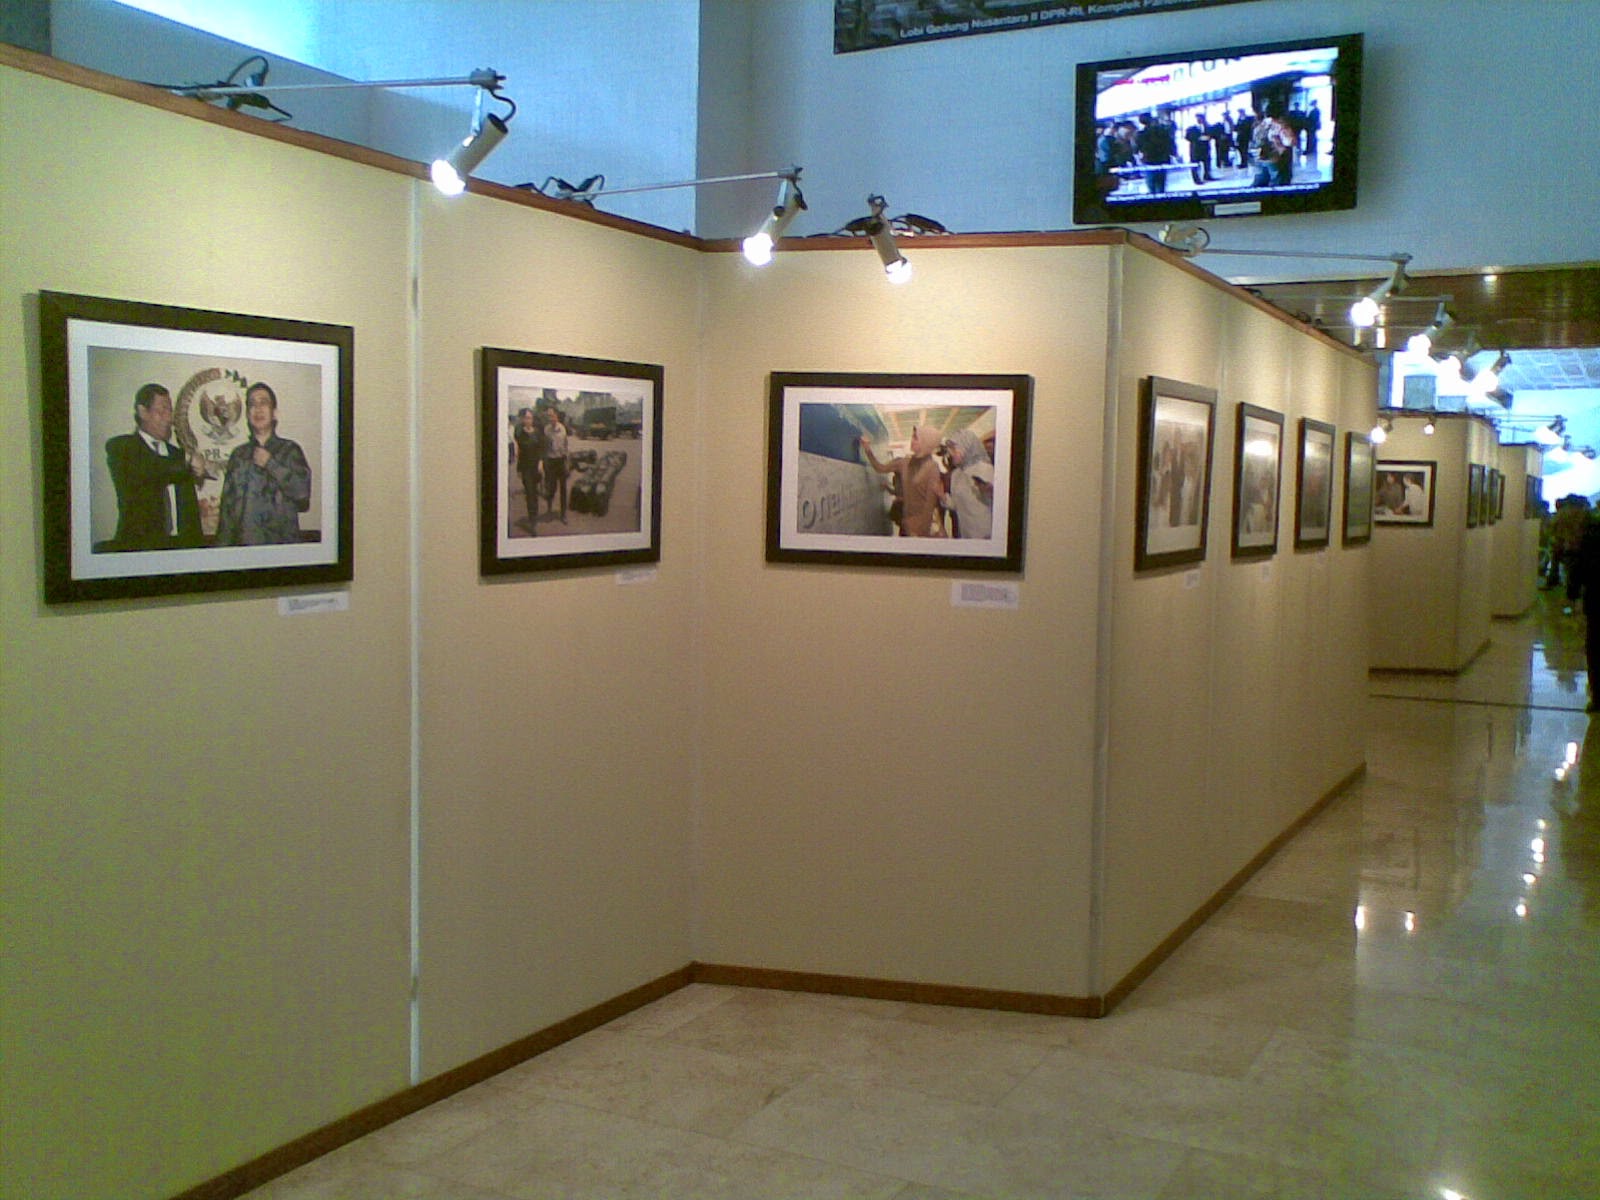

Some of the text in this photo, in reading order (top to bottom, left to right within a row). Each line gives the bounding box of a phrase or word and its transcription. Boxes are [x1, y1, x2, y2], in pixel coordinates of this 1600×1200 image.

[925, 22, 969, 33] Gedung
[970, 14, 1029, 28] Nusantara
[1087, 1, 1141, 14] Komplek
